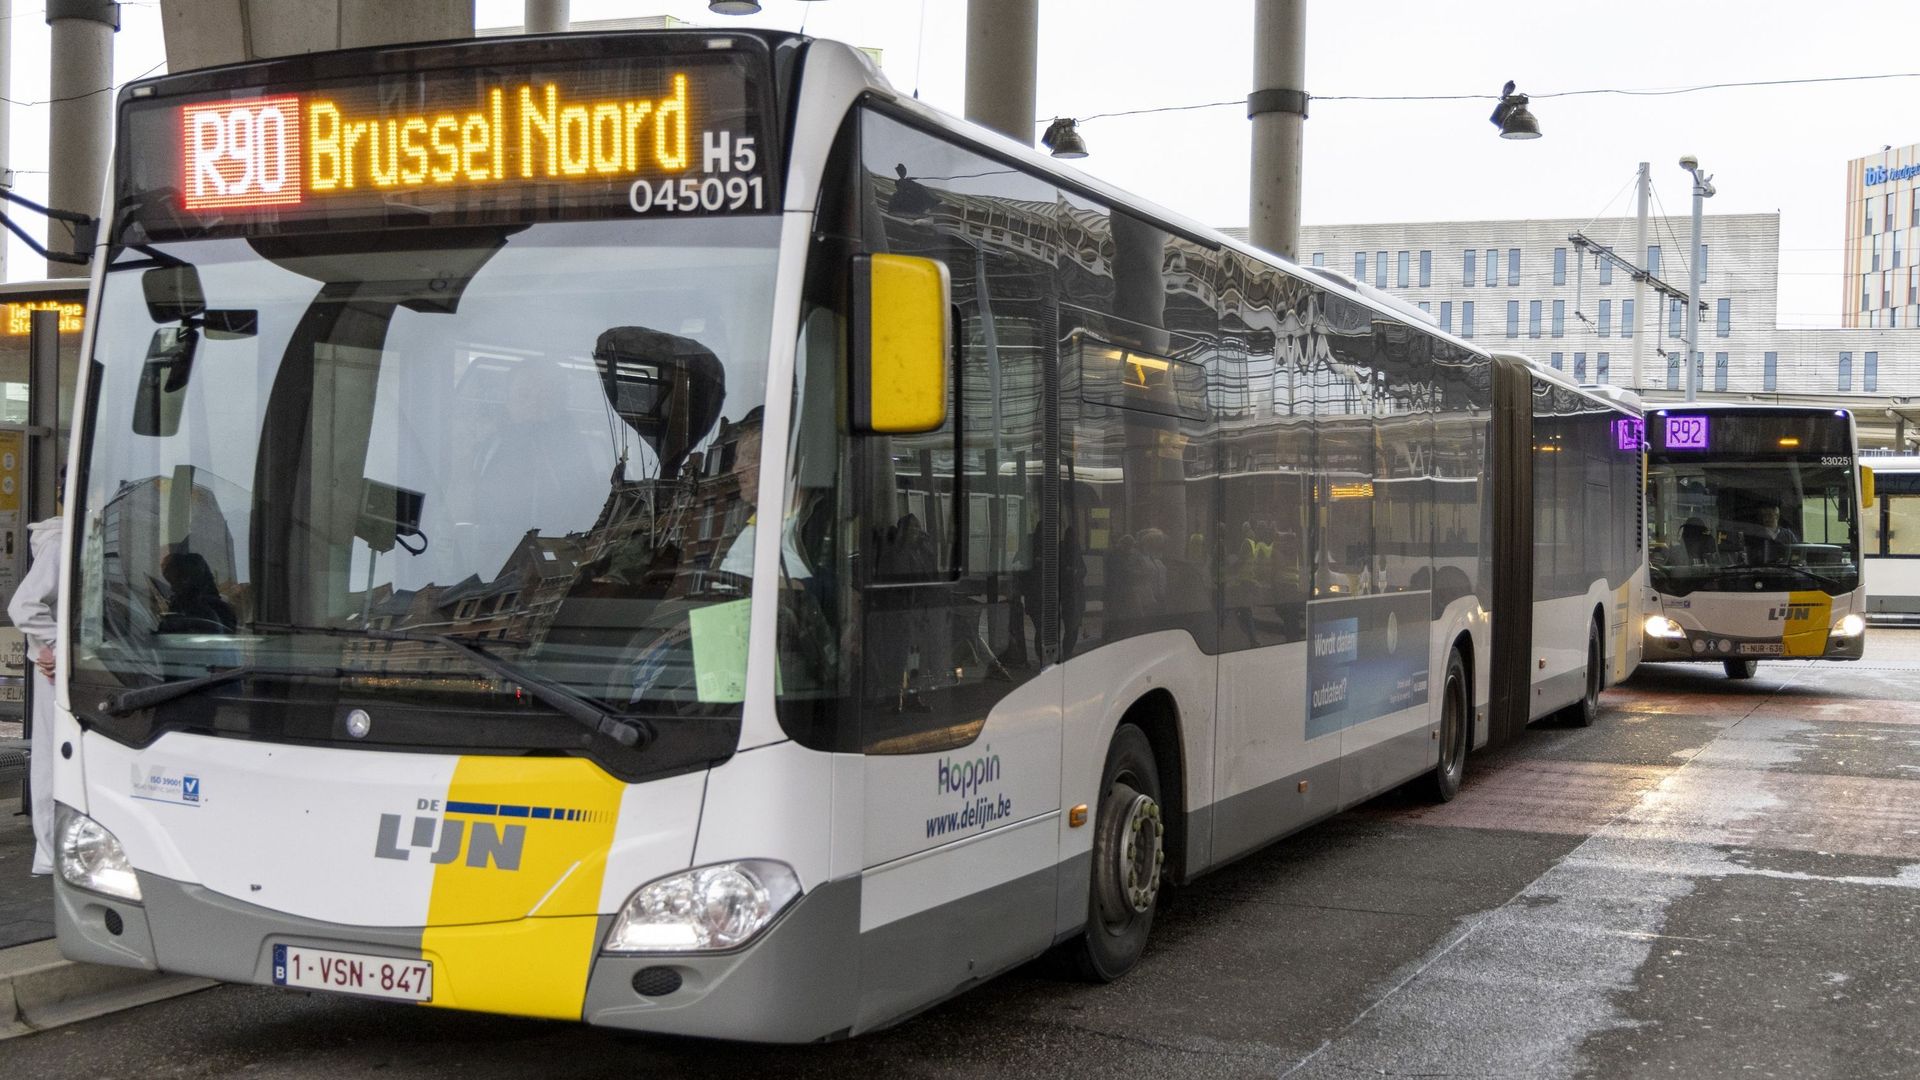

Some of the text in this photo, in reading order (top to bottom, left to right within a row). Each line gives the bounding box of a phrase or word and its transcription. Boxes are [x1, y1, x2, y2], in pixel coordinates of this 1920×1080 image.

[194, 73, 687, 197] R90 Brussel Noord
[703, 131, 756, 173] H5
[1865, 166, 1888, 186] ibis
[629, 177, 763, 213] 045091
[1670, 420, 1701, 444] R92
[1821, 456, 1852, 466] 330251
[1768, 607, 1809, 621] LIJN
[150, 775, 162, 785] ISO
[938, 743, 1001, 798] hoppin
[416, 798, 440, 812] DE
[926, 793, 1012, 838] www.delijn.be
[374, 813, 527, 871] LIJN
[275, 953, 427, 994] B 1-VSN-847
